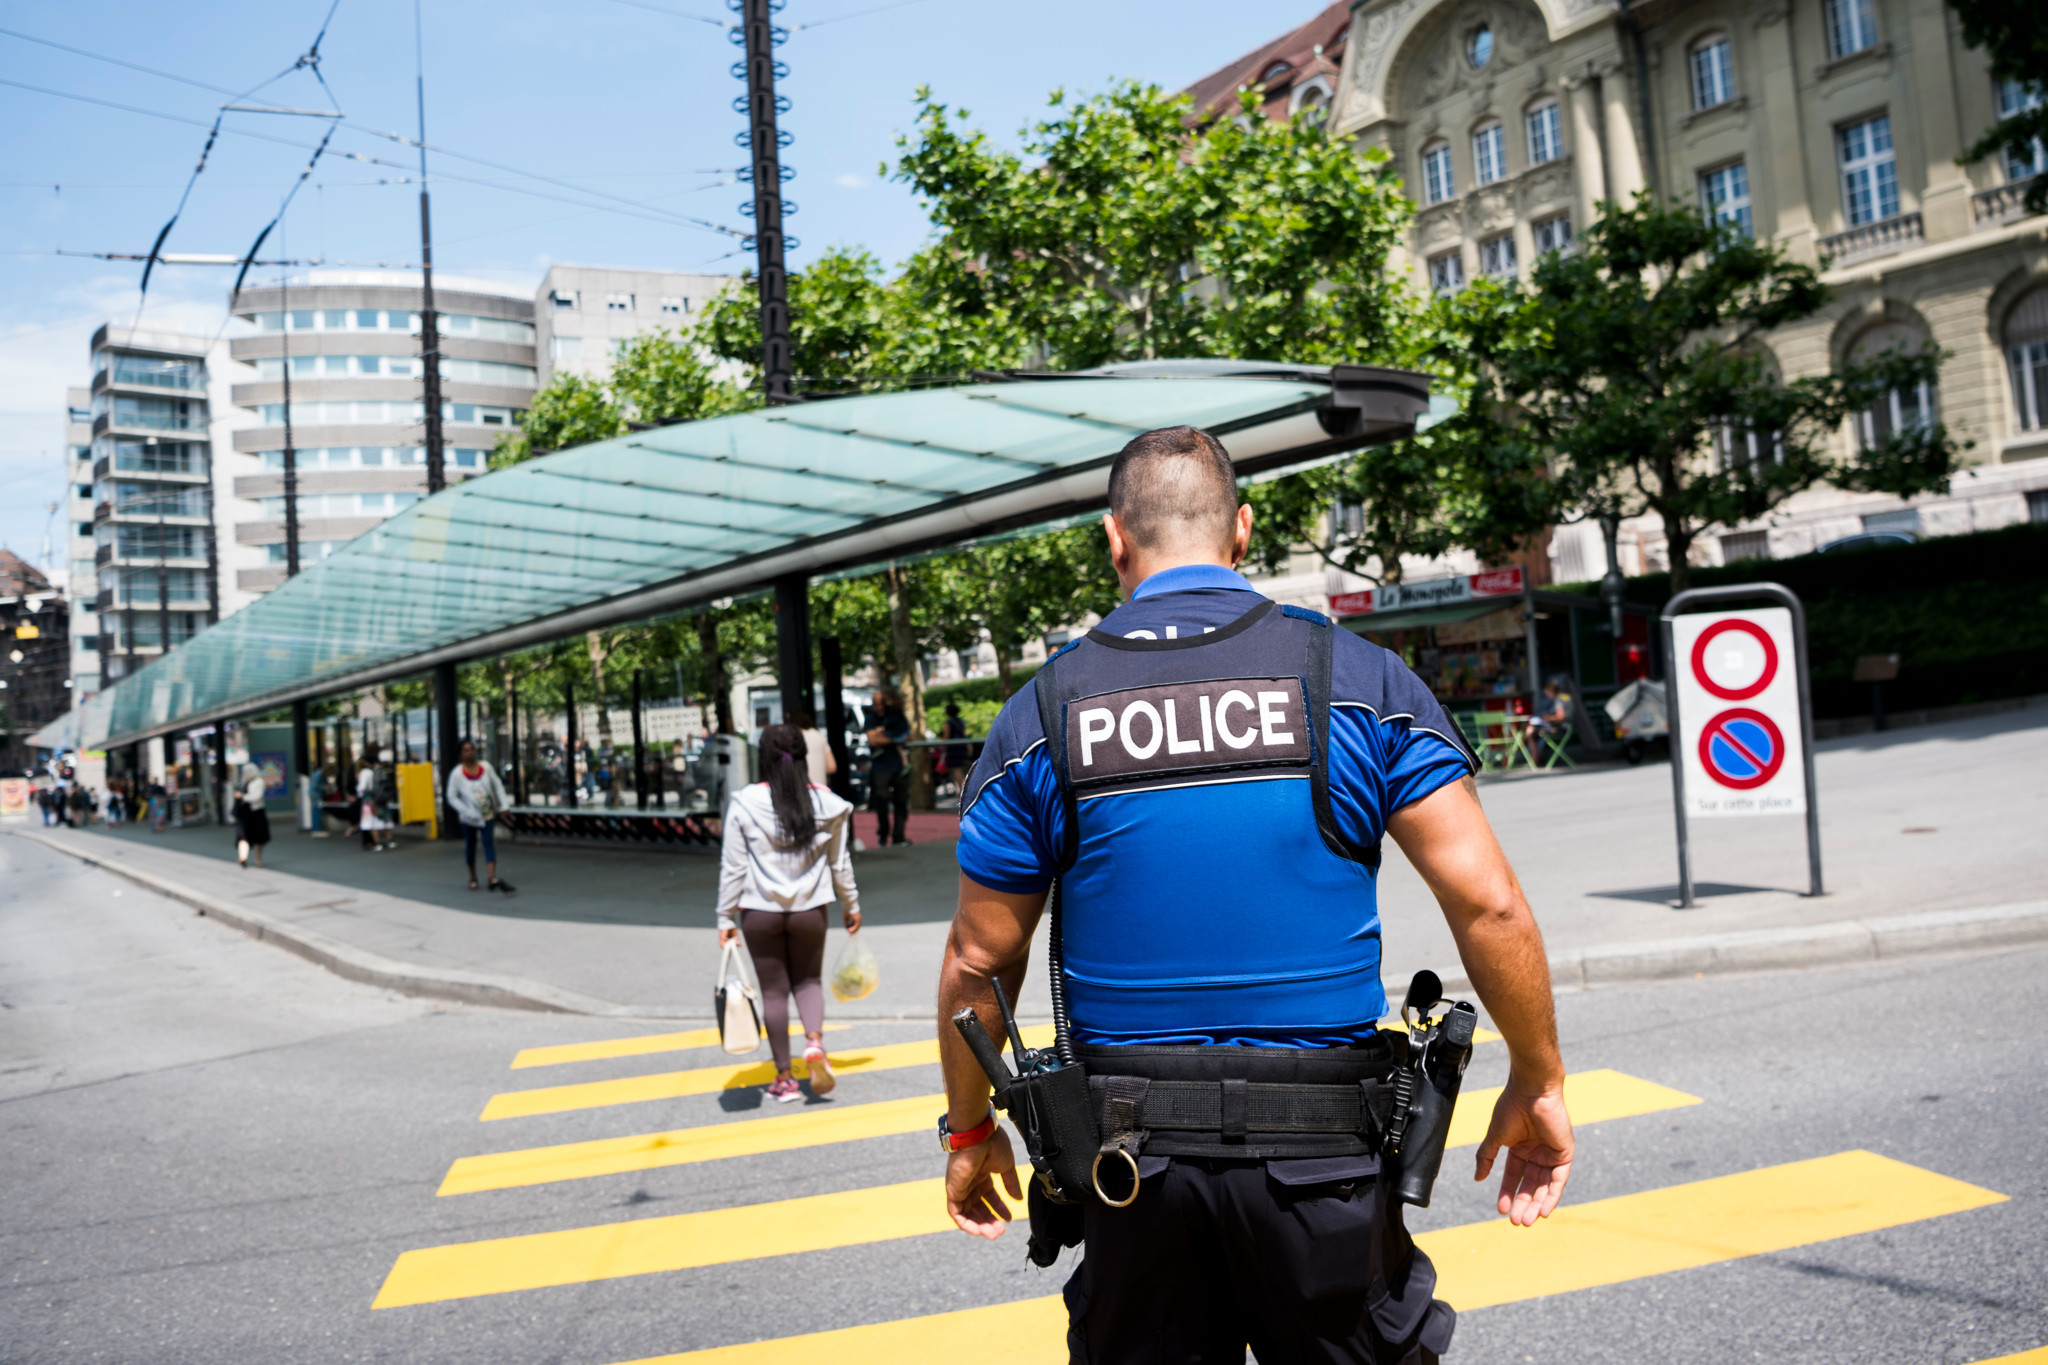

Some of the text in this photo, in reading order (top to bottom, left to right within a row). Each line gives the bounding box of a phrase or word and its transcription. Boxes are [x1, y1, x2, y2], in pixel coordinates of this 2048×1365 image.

[1380, 578, 1463, 607] Le Monopole
[1079, 690, 1295, 767] POLICE
[1698, 796, 1793, 810] Sur cette place
